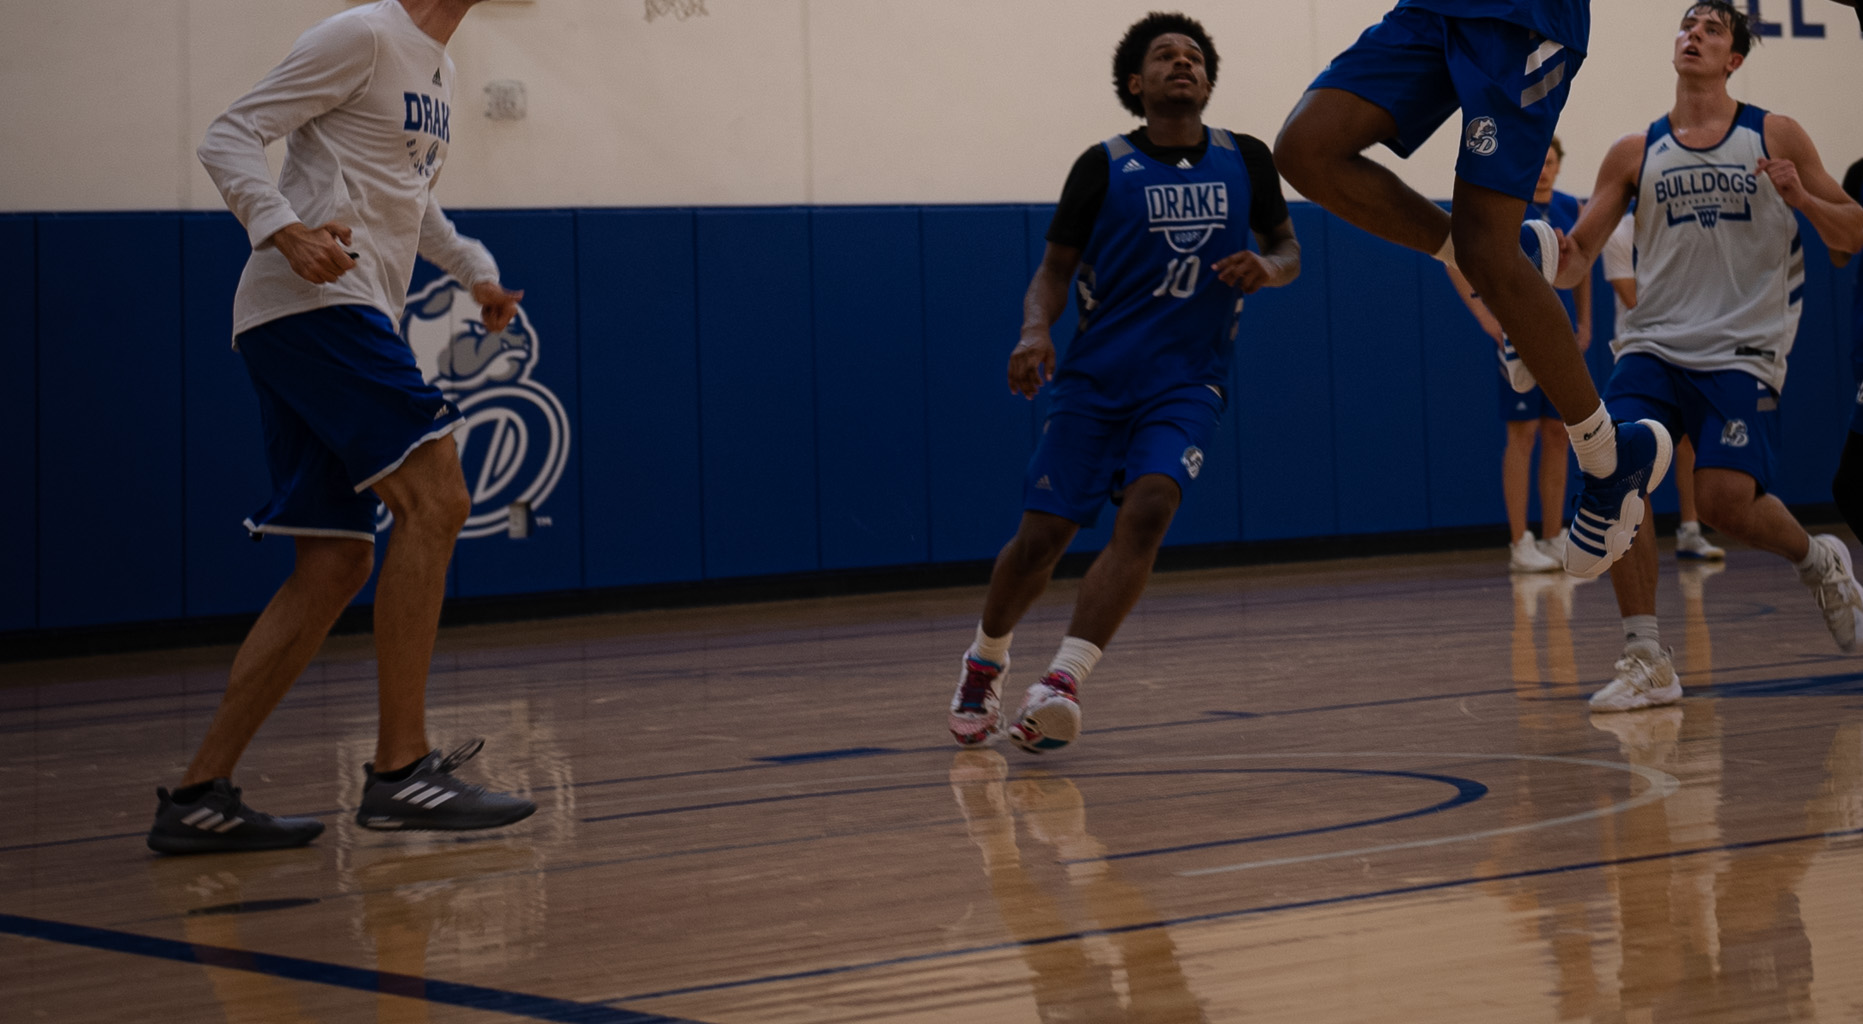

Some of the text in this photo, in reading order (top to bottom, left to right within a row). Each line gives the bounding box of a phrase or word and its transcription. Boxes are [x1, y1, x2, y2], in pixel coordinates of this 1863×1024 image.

[403, 91, 450, 144] DRAK
[1149, 185, 1226, 221] DRAKE
[1655, 172, 1758, 204] BULLDOGS
[1152, 255, 1201, 299] 10
